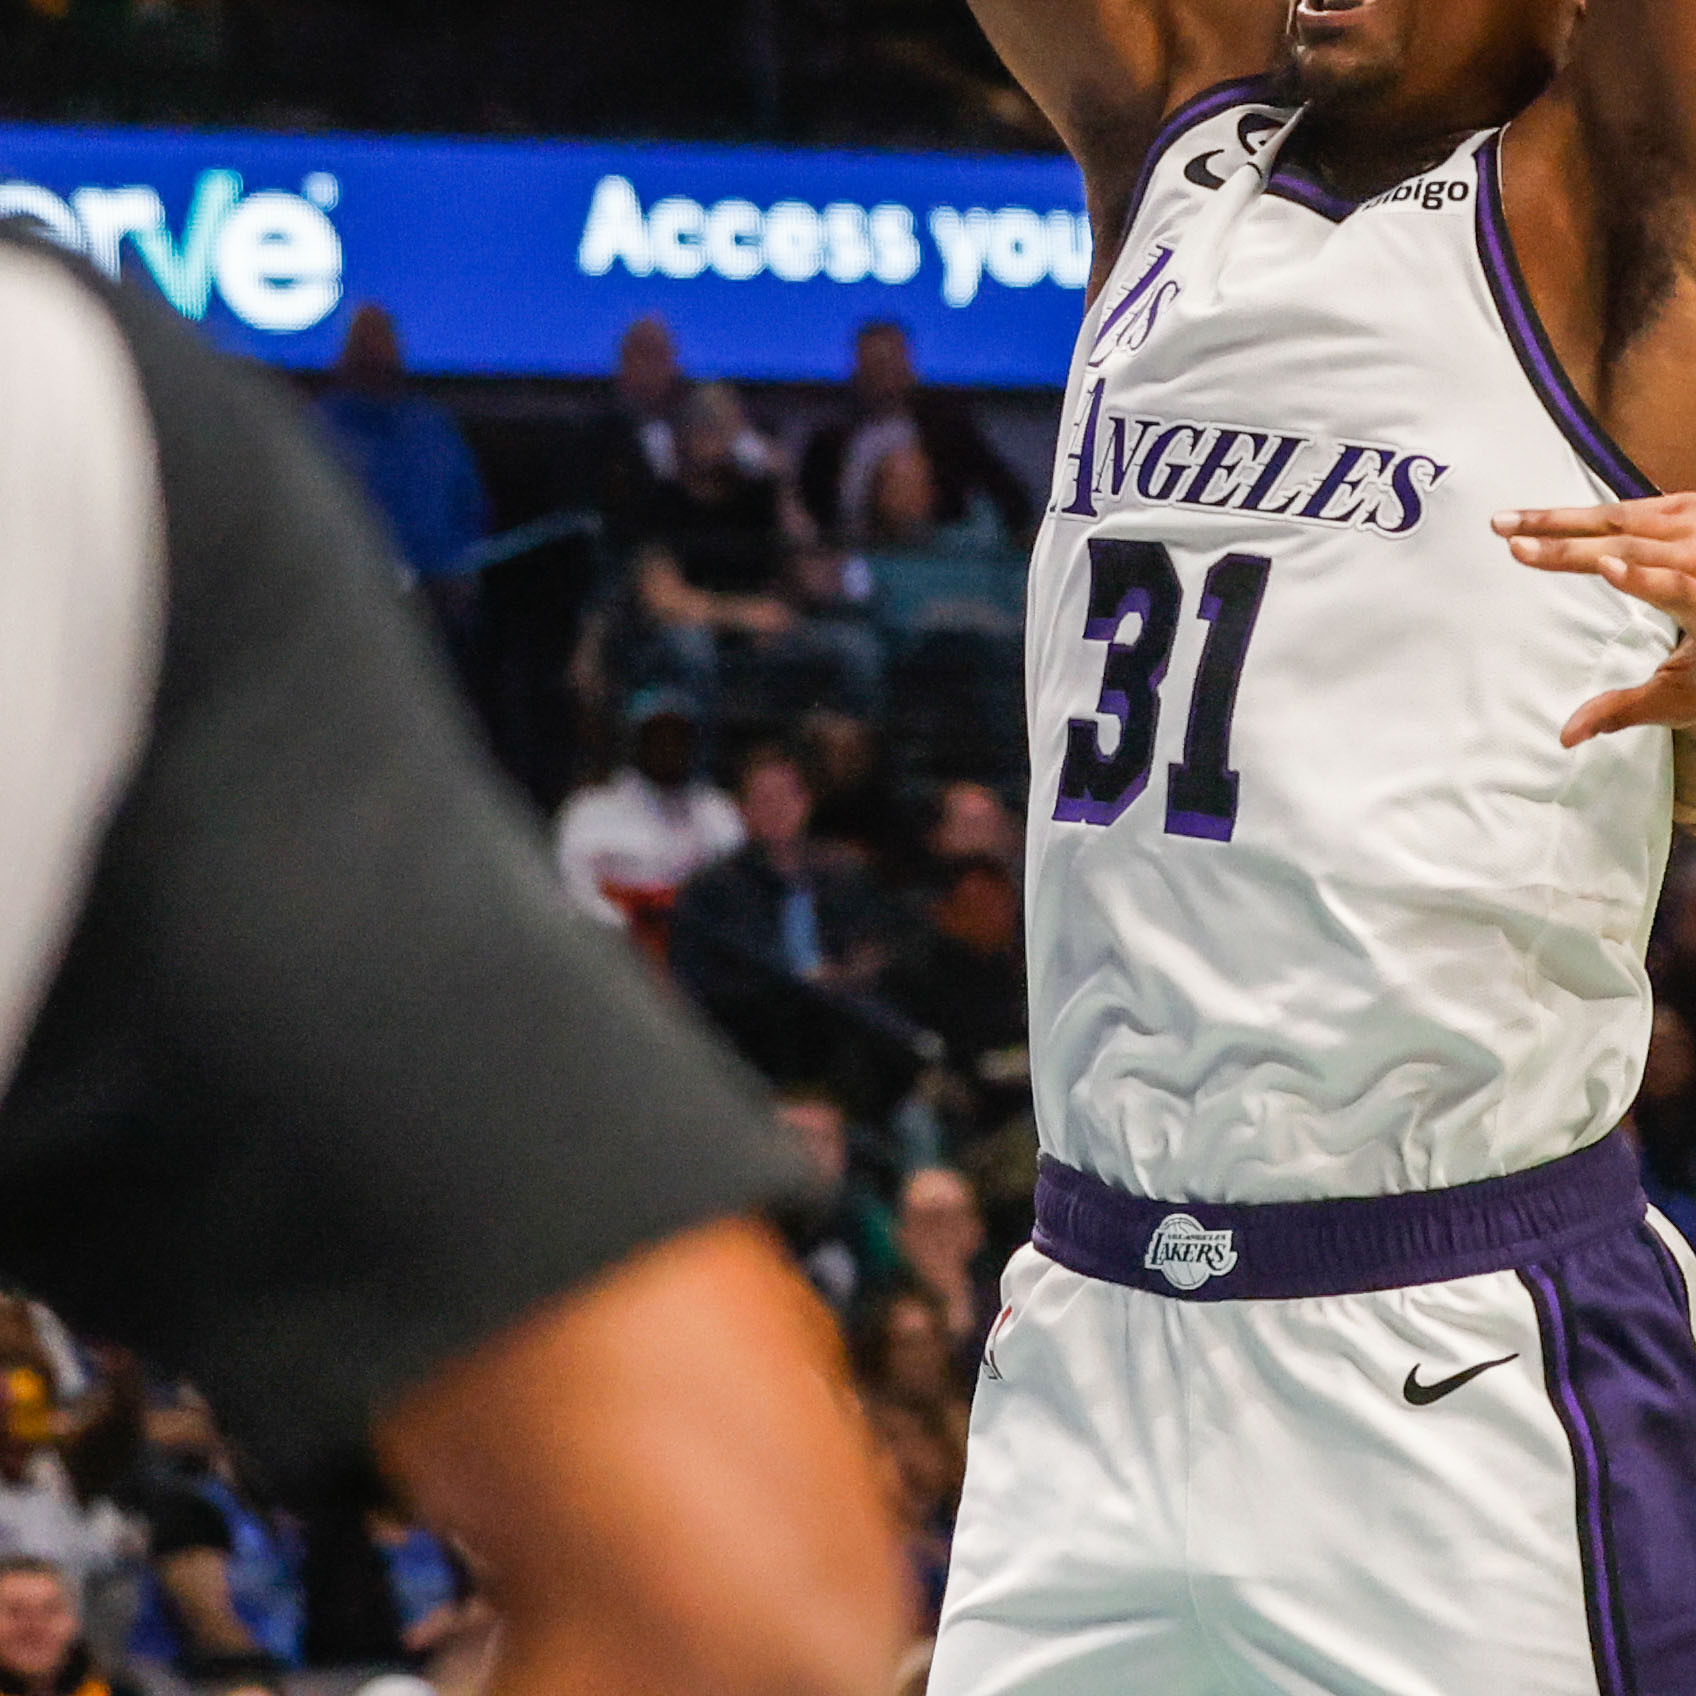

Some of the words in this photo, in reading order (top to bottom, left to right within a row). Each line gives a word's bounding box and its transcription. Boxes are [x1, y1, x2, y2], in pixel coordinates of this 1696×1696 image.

[578, 174, 920, 282] Access
[1052, 376, 1450, 534] ANGELES
[1051, 539, 1272, 843] 31
[1151, 1232, 1226, 1271] LAKERS
